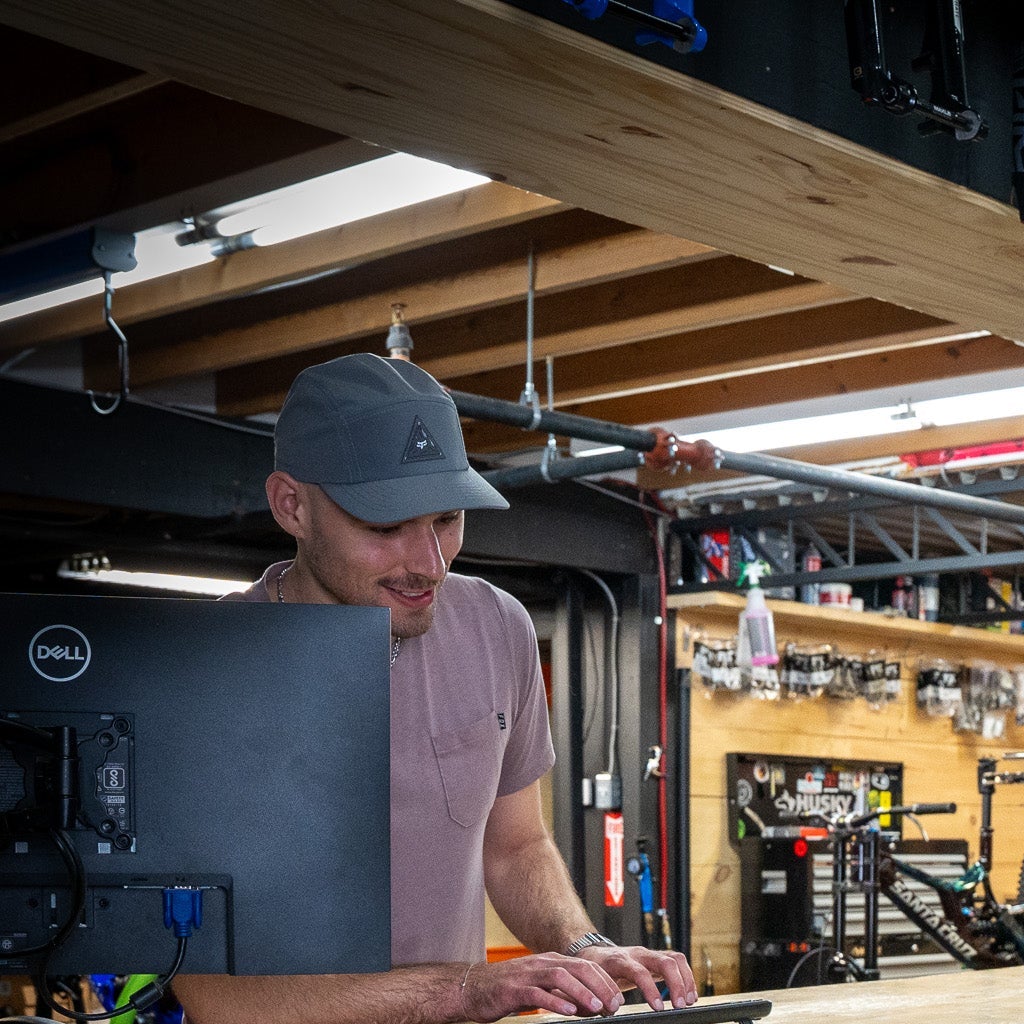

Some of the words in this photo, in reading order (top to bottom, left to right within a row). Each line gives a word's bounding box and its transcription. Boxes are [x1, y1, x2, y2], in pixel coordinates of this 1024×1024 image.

[37, 644, 85, 661] DELL
[796, 794, 853, 815] HUSKY
[889, 880, 941, 929] SANTA
[937, 922, 978, 959] CRUZ
